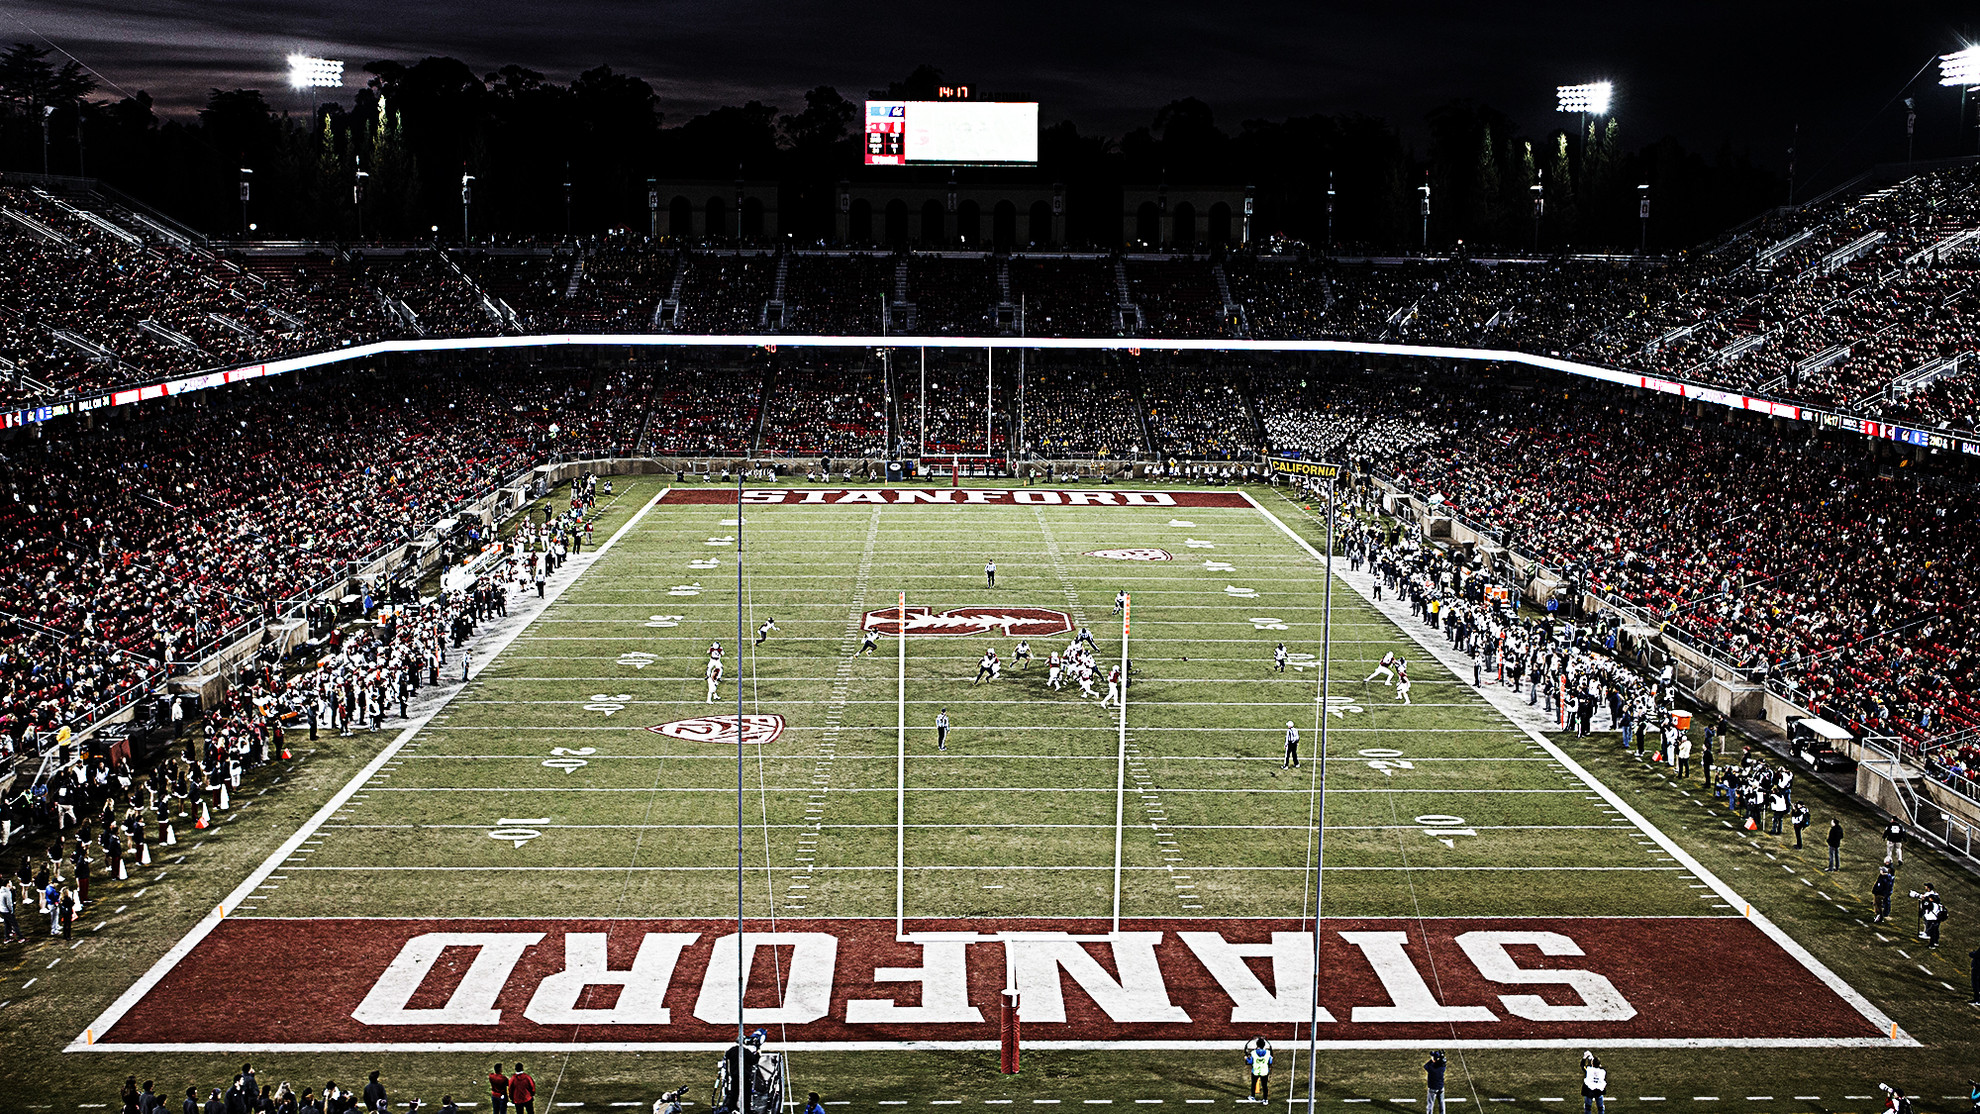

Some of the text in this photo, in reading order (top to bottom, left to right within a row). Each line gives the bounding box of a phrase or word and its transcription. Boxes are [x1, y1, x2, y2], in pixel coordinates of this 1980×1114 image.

[939, 86, 968, 98] 14:17
[1272, 460, 1336, 477] CALIFORNIA
[741, 488, 1178, 506] STANFORD
[583, 694, 632, 711] 30
[1315, 696, 1364, 713] 30
[541, 746, 597, 768] 20
[1358, 748, 1415, 769] 20
[488, 817, 551, 840] 10
[1415, 814, 1478, 837] 10
[351, 930, 1638, 1025] STANFORD
